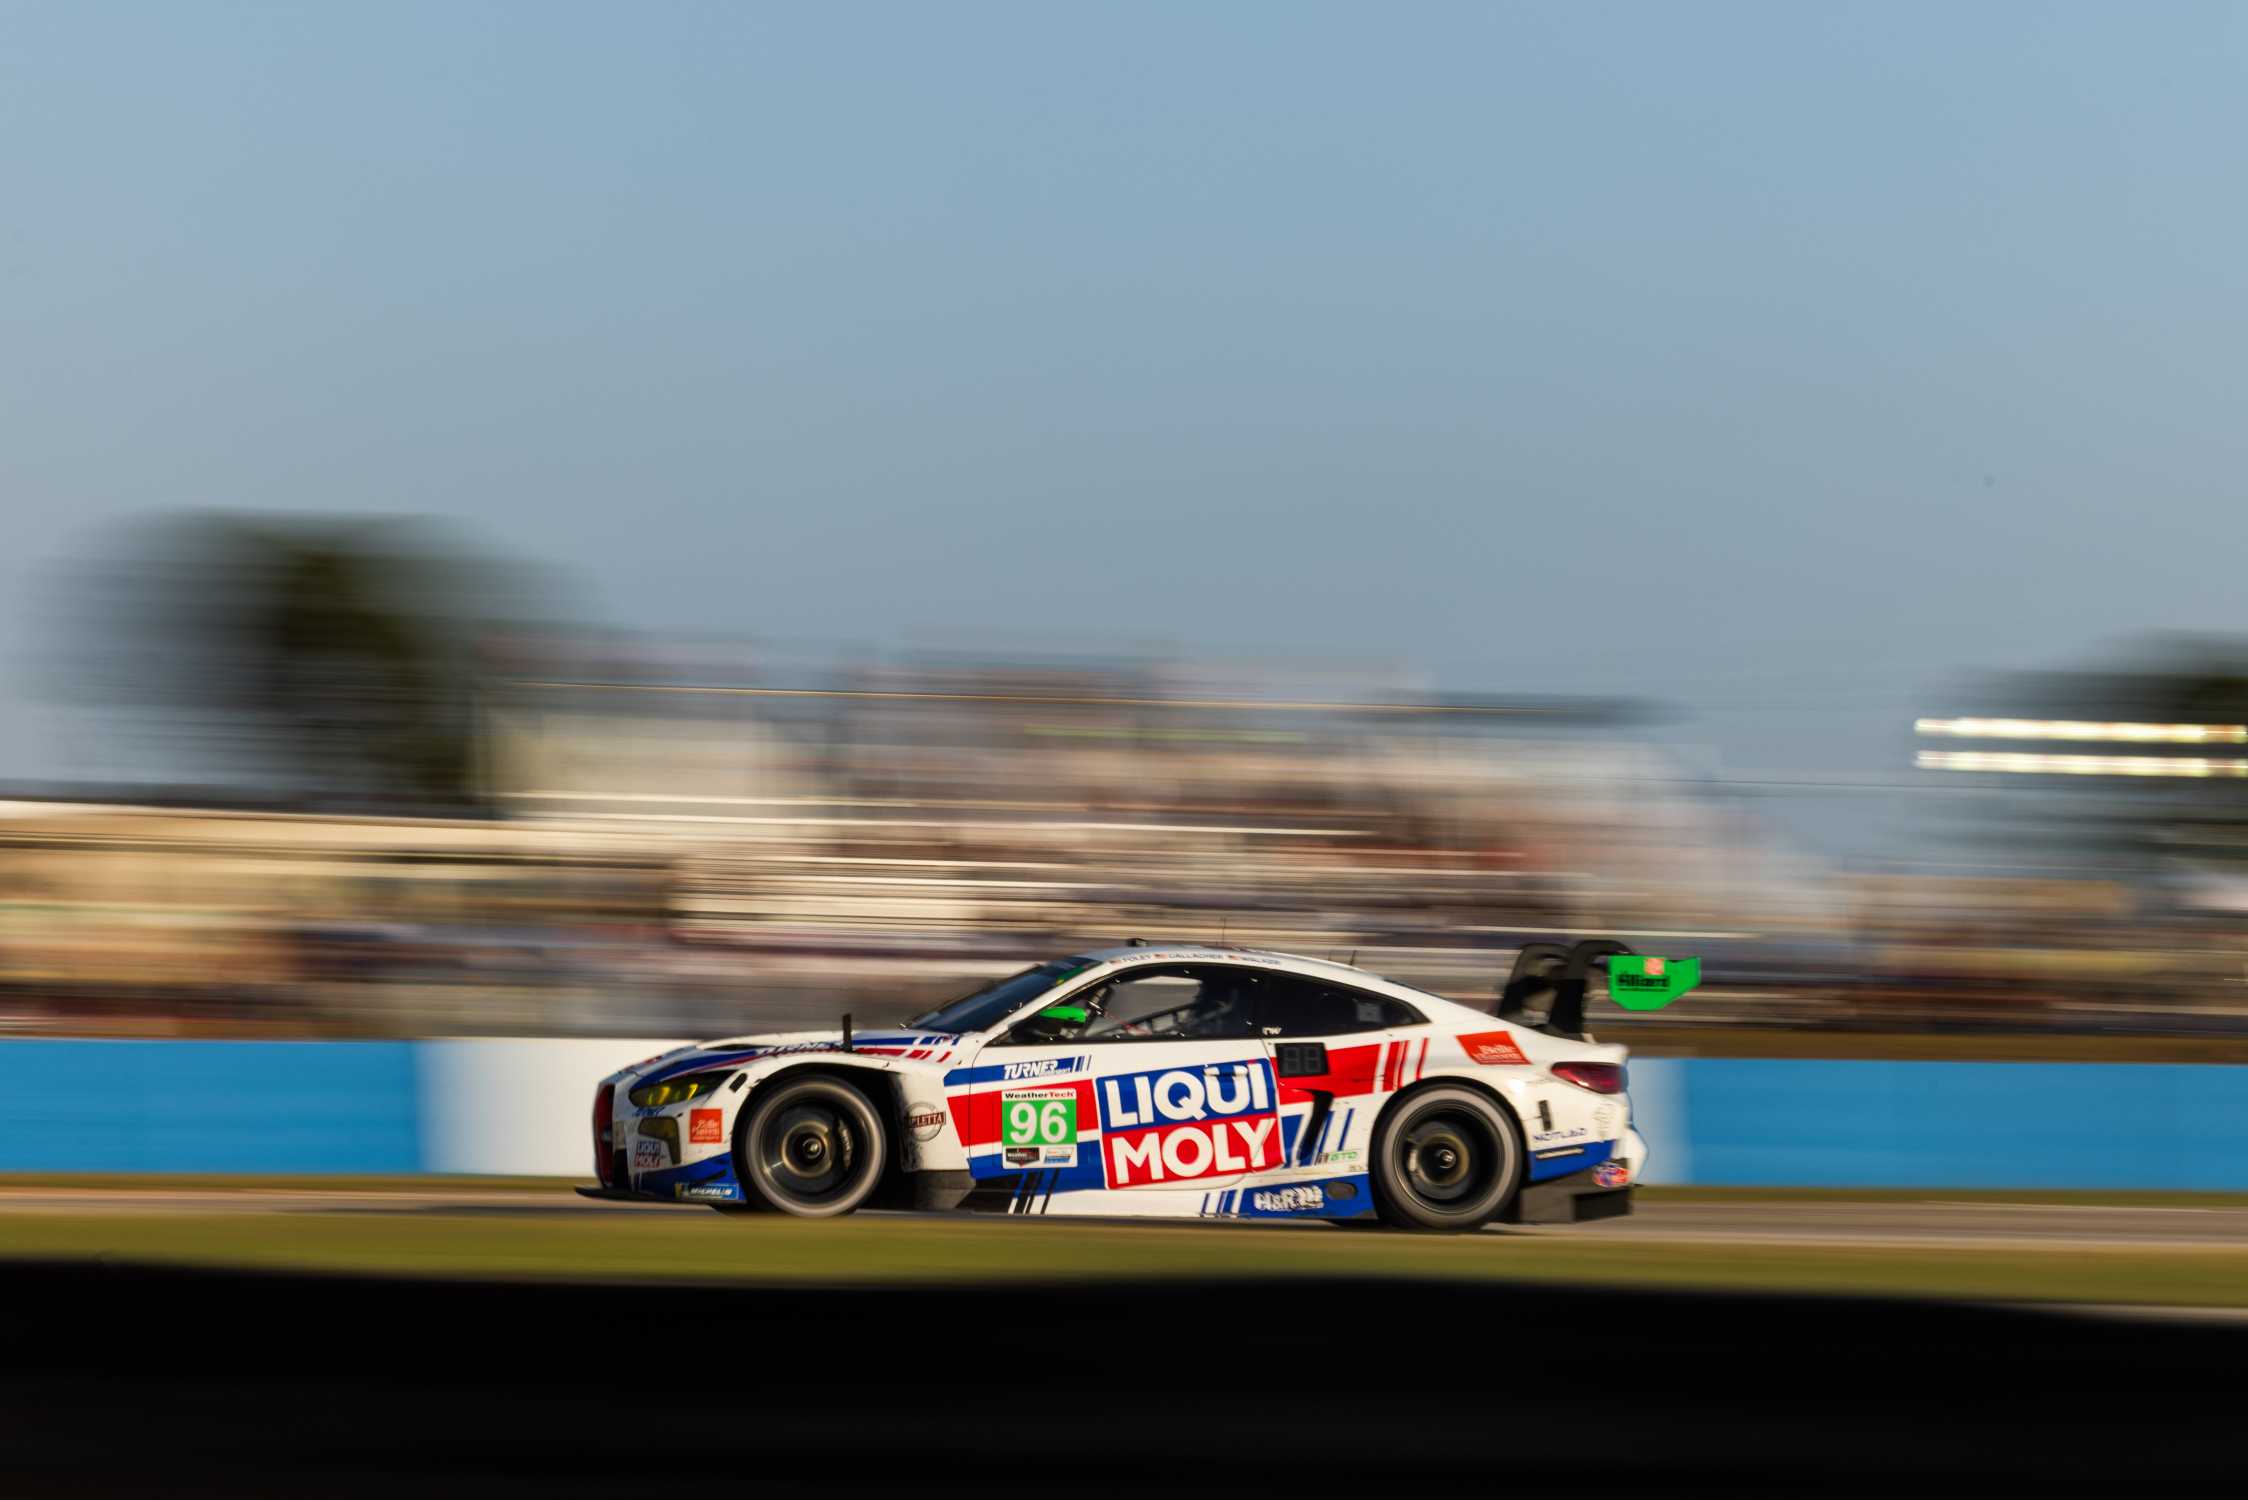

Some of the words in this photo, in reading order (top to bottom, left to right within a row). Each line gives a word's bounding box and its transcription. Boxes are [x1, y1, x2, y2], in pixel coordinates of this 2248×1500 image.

[1003, 1060, 1058, 1080] TURNER
[1005, 1091, 1074, 1099] WeatherTech
[1105, 1062, 1269, 1128] LIQUI
[1010, 1102, 1068, 1143] 96
[1111, 1118, 1277, 1185] MOLY
